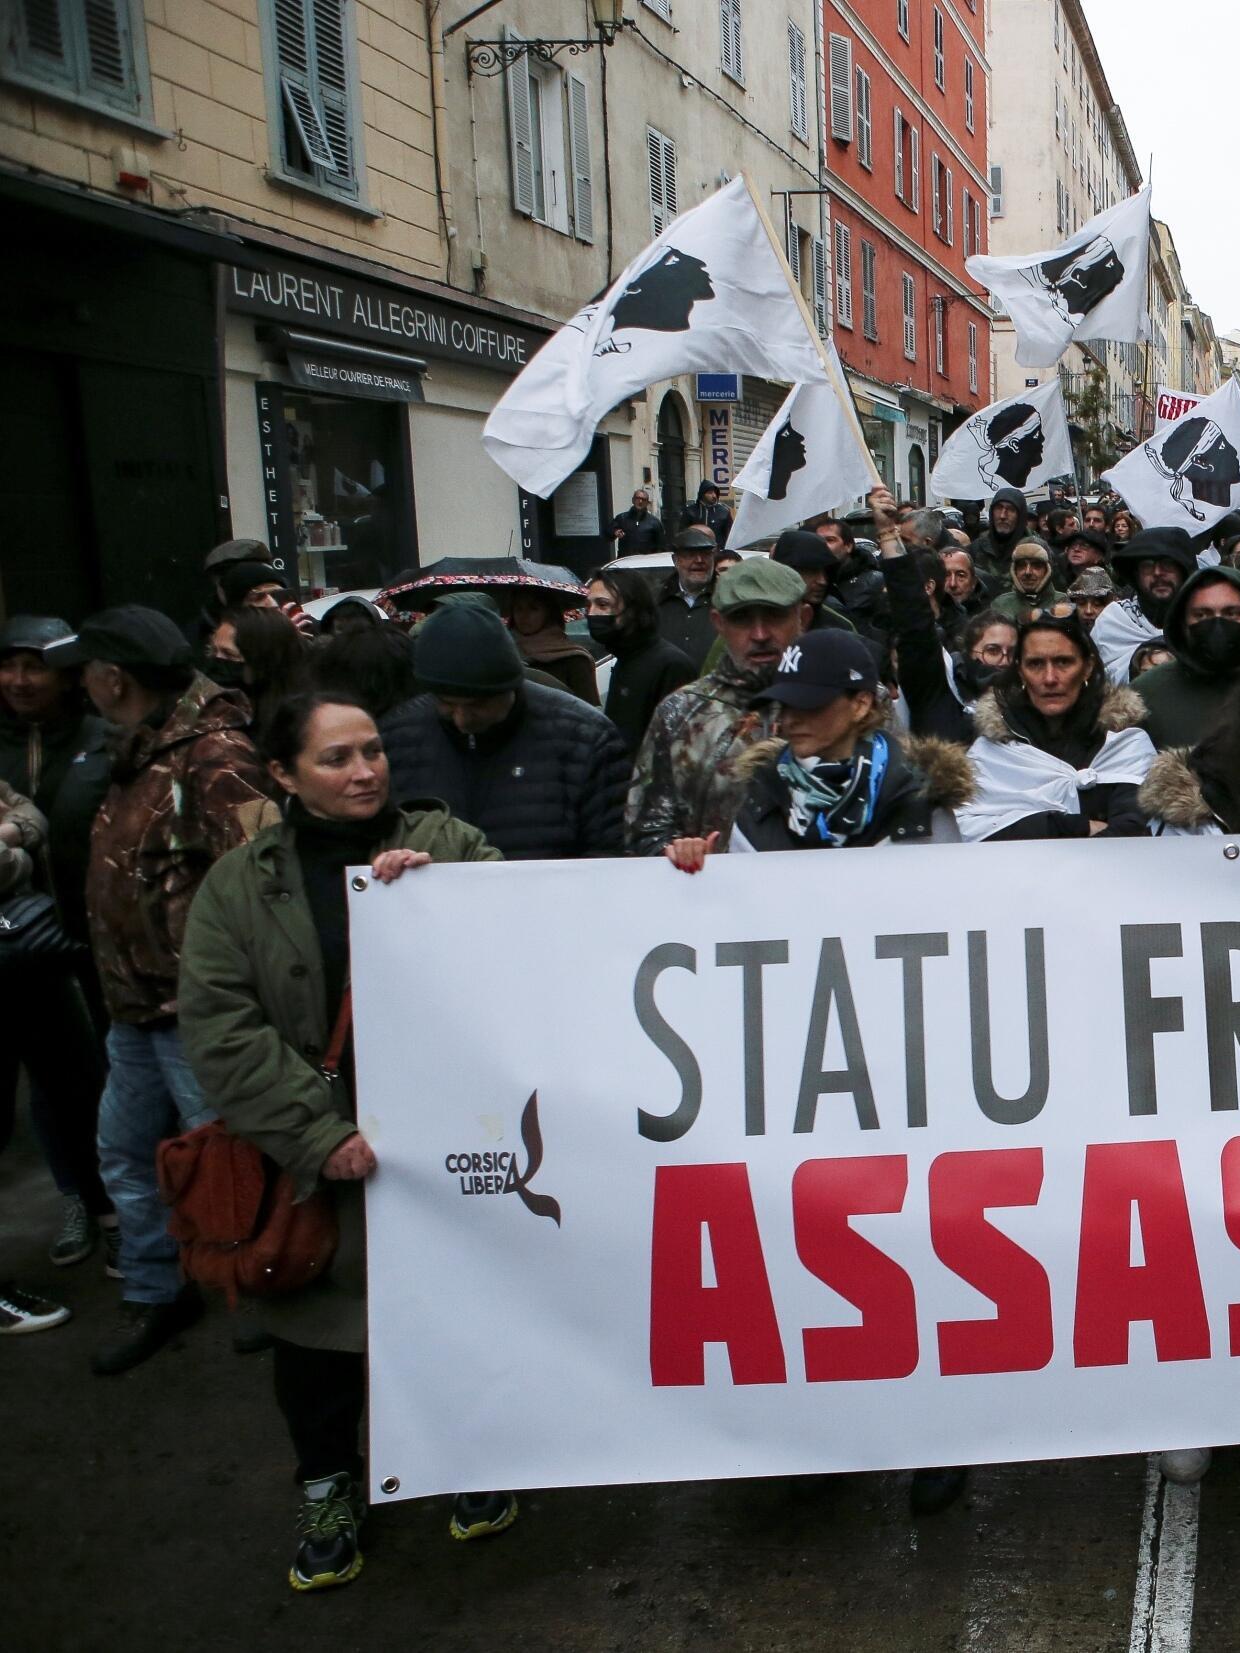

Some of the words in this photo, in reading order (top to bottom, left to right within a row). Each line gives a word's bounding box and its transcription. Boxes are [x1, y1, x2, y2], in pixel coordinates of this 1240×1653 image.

[232, 267, 343, 320] LAURENT
[353, 294, 448, 346] ALLEGRINI
[451, 320, 527, 365] COIFFURE
[374, 375, 385, 387] DE
[385, 377, 412, 392] FRANCE
[700, 389, 736, 399] mercerie
[633, 927, 1050, 1143] STATU
